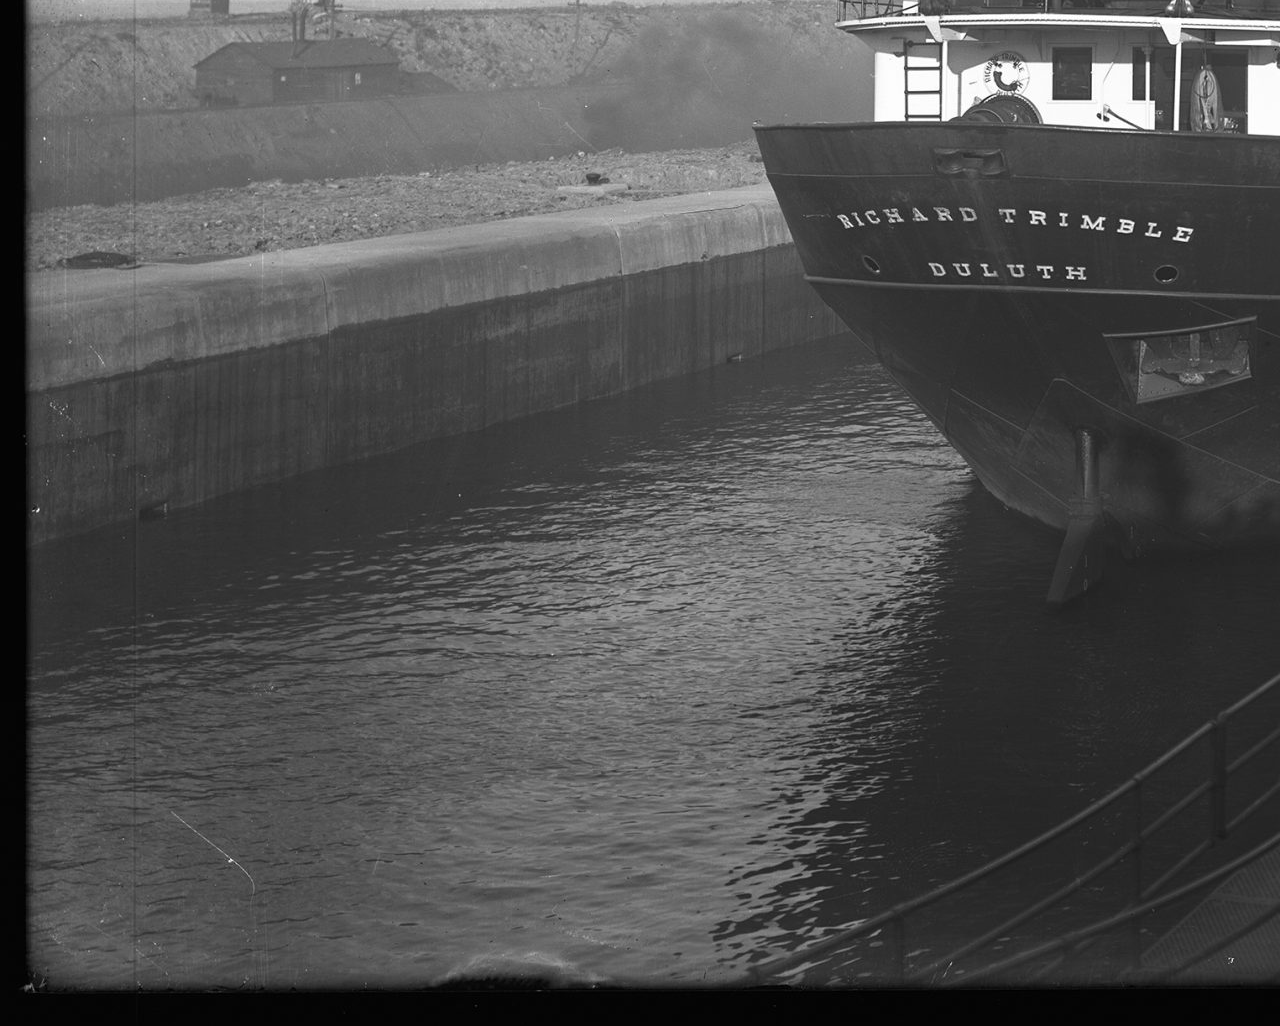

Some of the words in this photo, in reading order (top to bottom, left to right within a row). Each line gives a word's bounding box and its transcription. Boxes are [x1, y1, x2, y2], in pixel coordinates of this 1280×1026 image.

[837, 206, 978, 229] RICHARD
[998, 208, 1194, 243] TRIMBLE
[928, 262, 1087, 281] DULUTH
